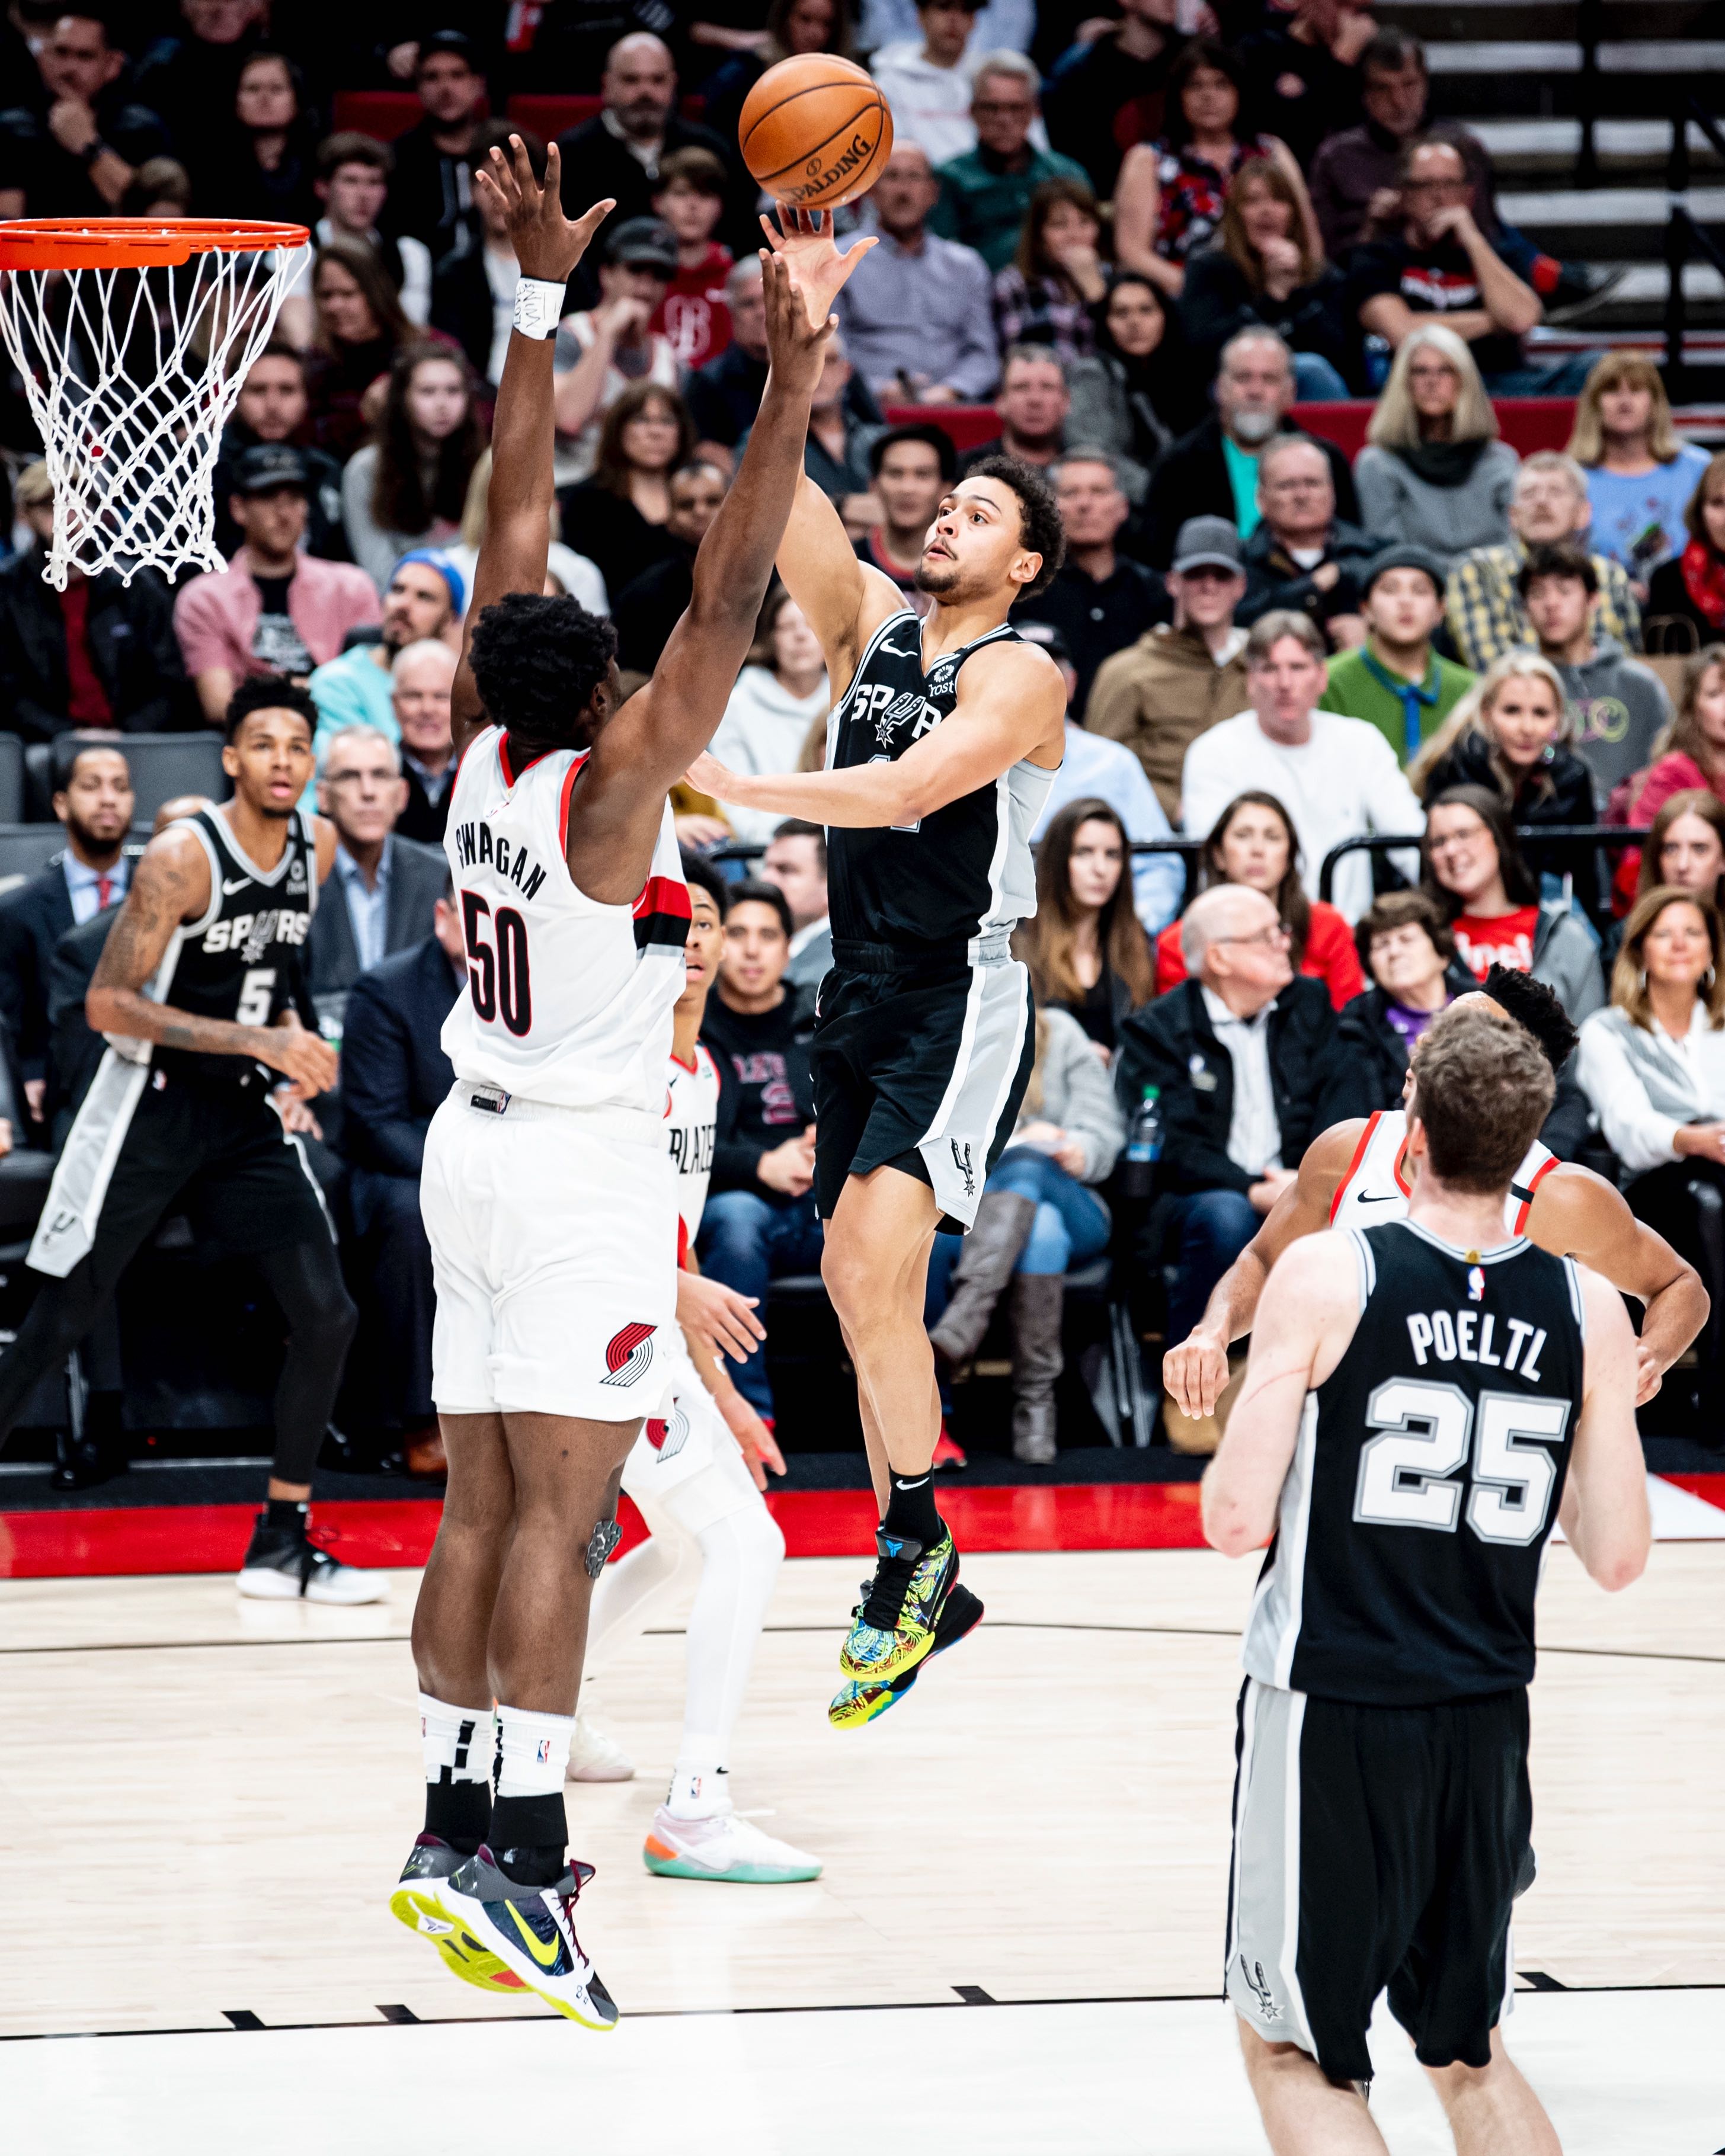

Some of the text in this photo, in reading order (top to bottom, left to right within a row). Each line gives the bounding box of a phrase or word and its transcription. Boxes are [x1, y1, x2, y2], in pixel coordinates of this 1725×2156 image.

[928, 680, 955, 697] rost
[456, 821, 547, 901] SWAGAN
[236, 968, 277, 1027] 5
[461, 889, 532, 1037] 50
[1406, 1309, 1547, 1383] POELTL
[1352, 1376, 1572, 1547] 25
